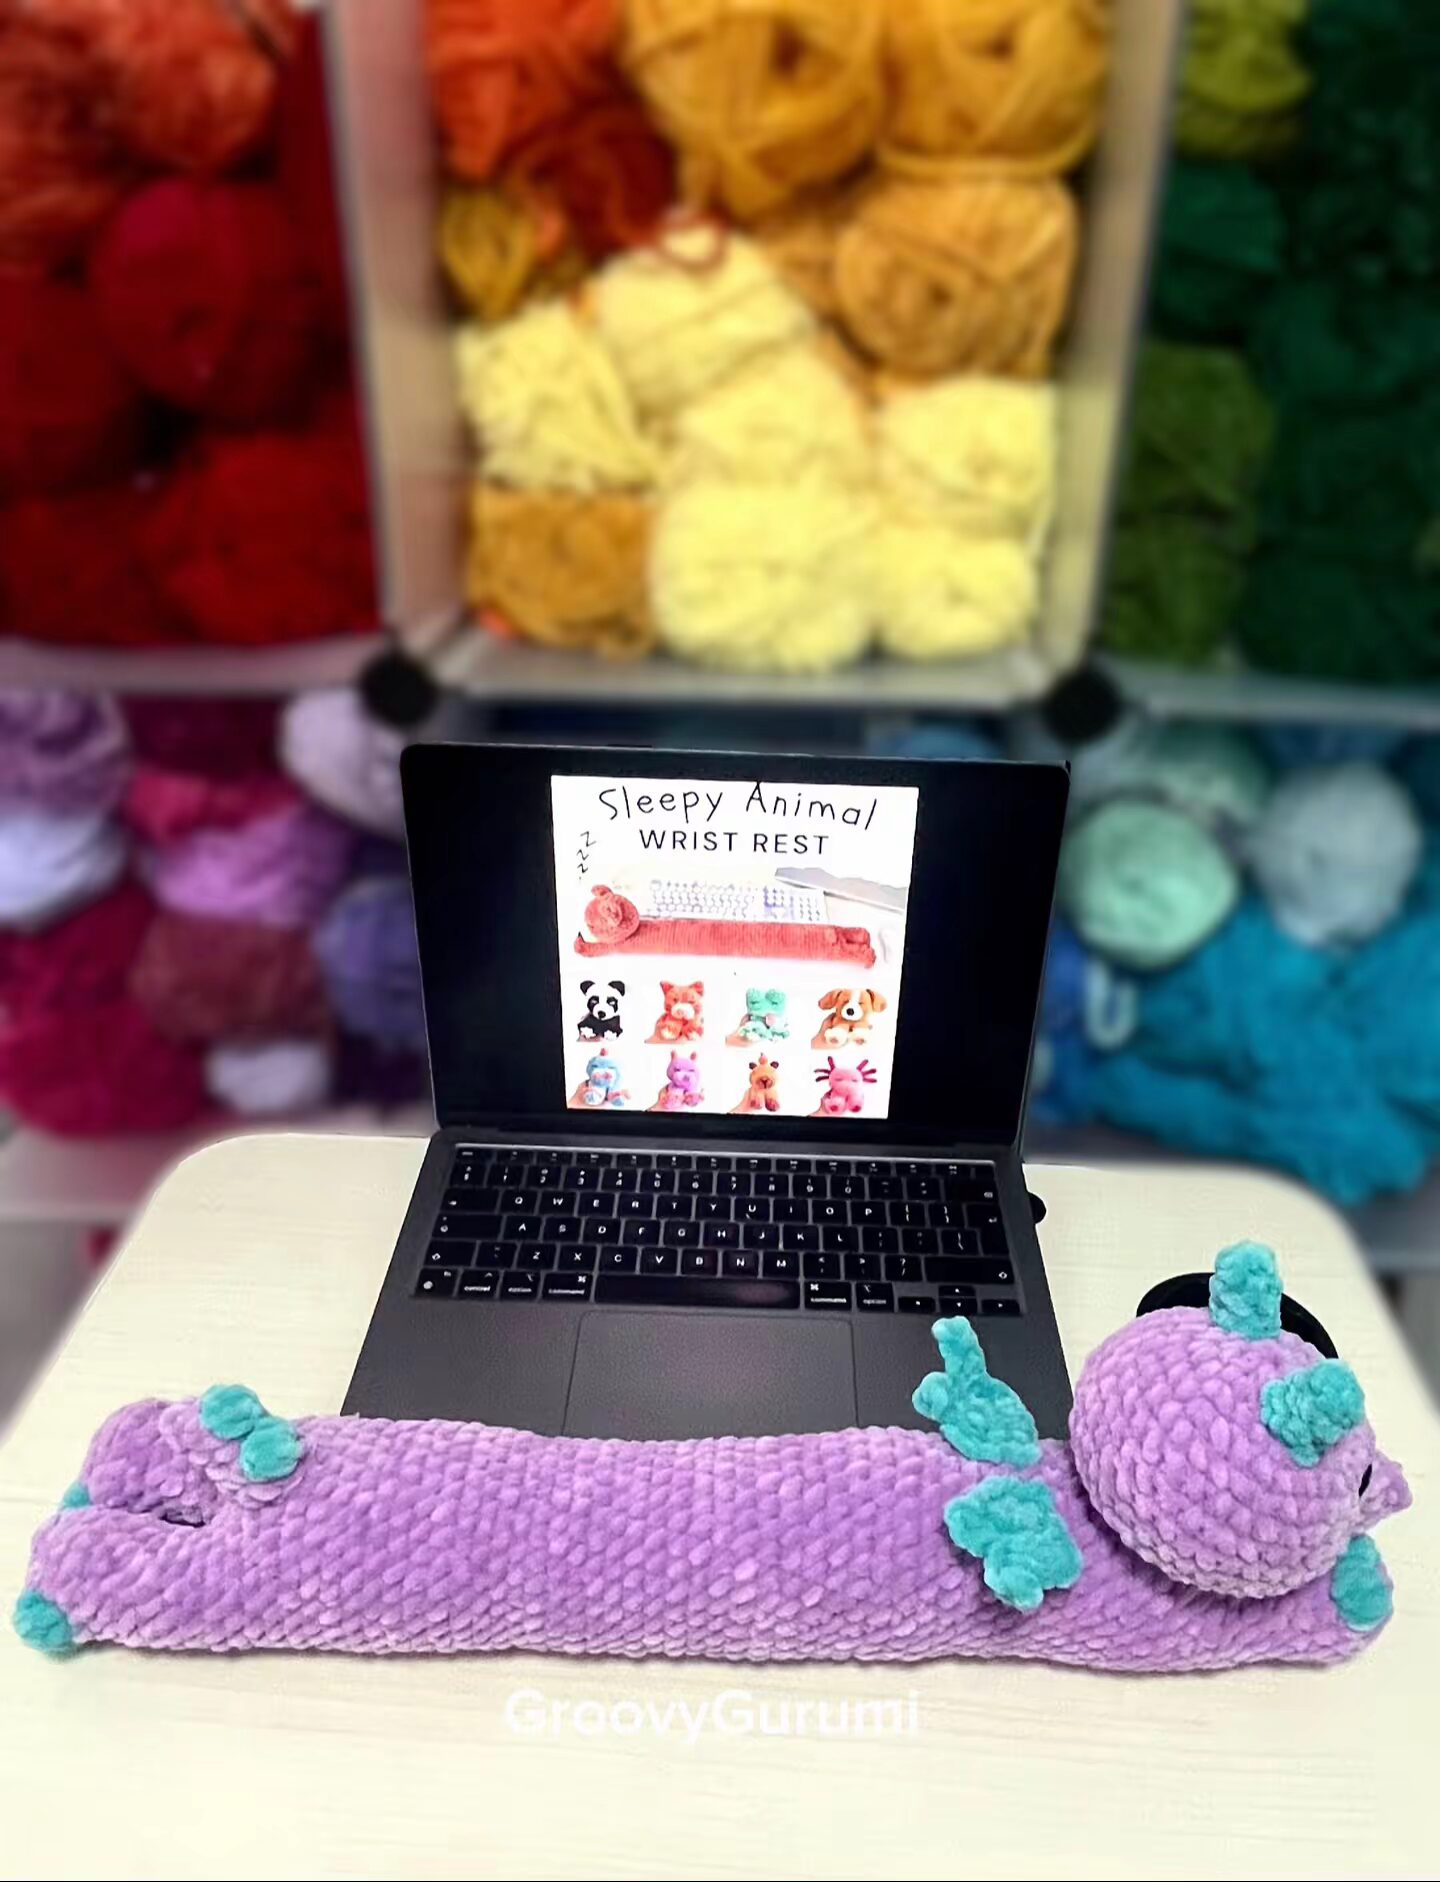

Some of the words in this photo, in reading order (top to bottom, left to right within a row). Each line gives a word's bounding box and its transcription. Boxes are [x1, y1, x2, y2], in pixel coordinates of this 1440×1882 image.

[598, 785, 724, 824] Sleepy
[745, 781, 878, 830] Animal
[639, 829, 738, 852] WRIST
[753, 833, 829, 855] REST
[514, 1196, 523, 1205] Q
[553, 1198, 564, 1206] W
[671, 1202, 678, 1210] T
[710, 1203, 717, 1212] Y
[748, 1204, 757, 1213] U
[825, 1207, 834, 1215] O
[865, 1208, 873, 1216] P
[518, 1223, 527, 1232] A
[759, 1231, 765, 1240] J
[797, 1233, 805, 1241] K
[837, 1234, 843, 1242] L
[532, 1251, 541, 1260] Z
[574, 1253, 582, 1261] X
[614, 1254, 622, 1263] C
[655, 1255, 664, 1264] V
[736, 1257, 745, 1267] N
[776, 1259, 787, 1268] M
